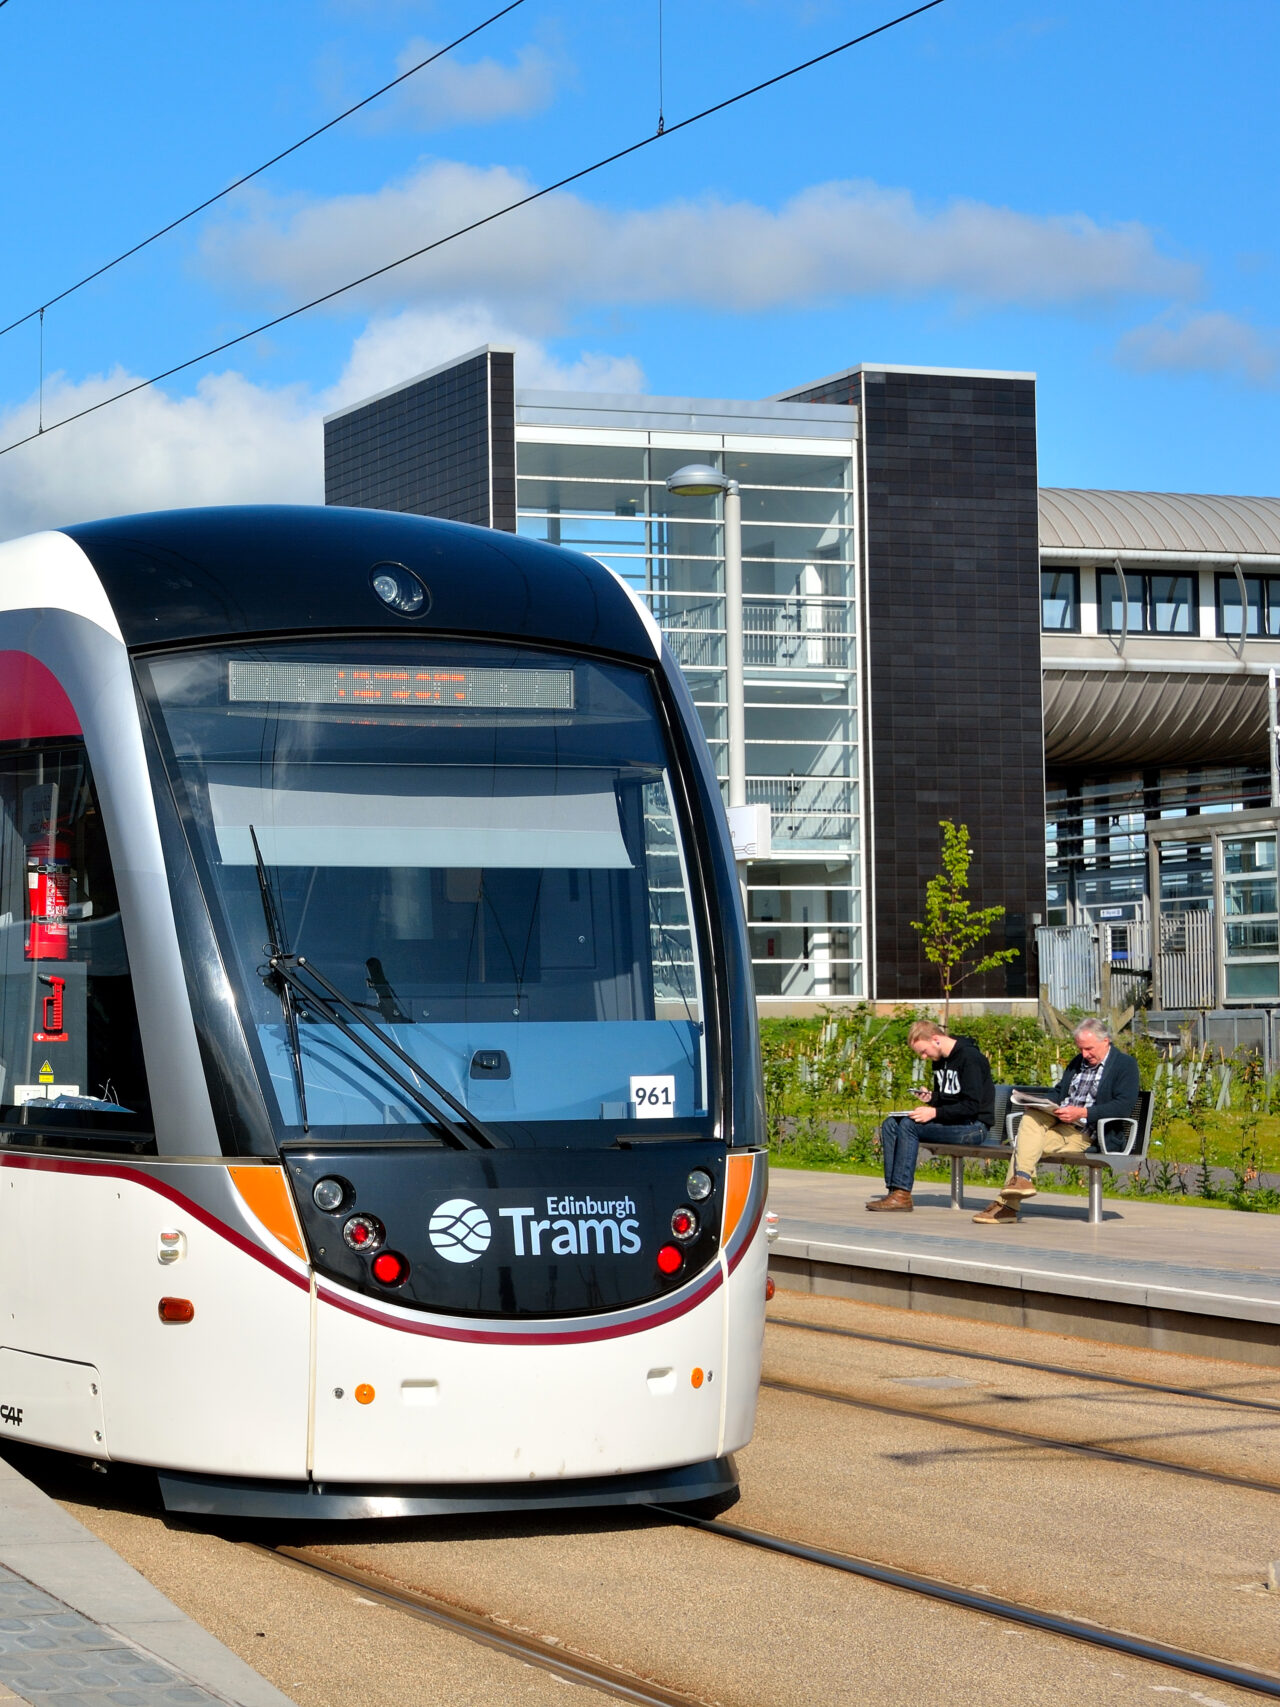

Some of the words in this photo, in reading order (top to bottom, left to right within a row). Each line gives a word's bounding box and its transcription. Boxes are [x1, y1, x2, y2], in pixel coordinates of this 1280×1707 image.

[635, 1086, 672, 1106] 961
[546, 1195, 636, 1219] Edinburgh
[498, 1207, 642, 1256] Trams
[0, 1404, 23, 1427] CAF
